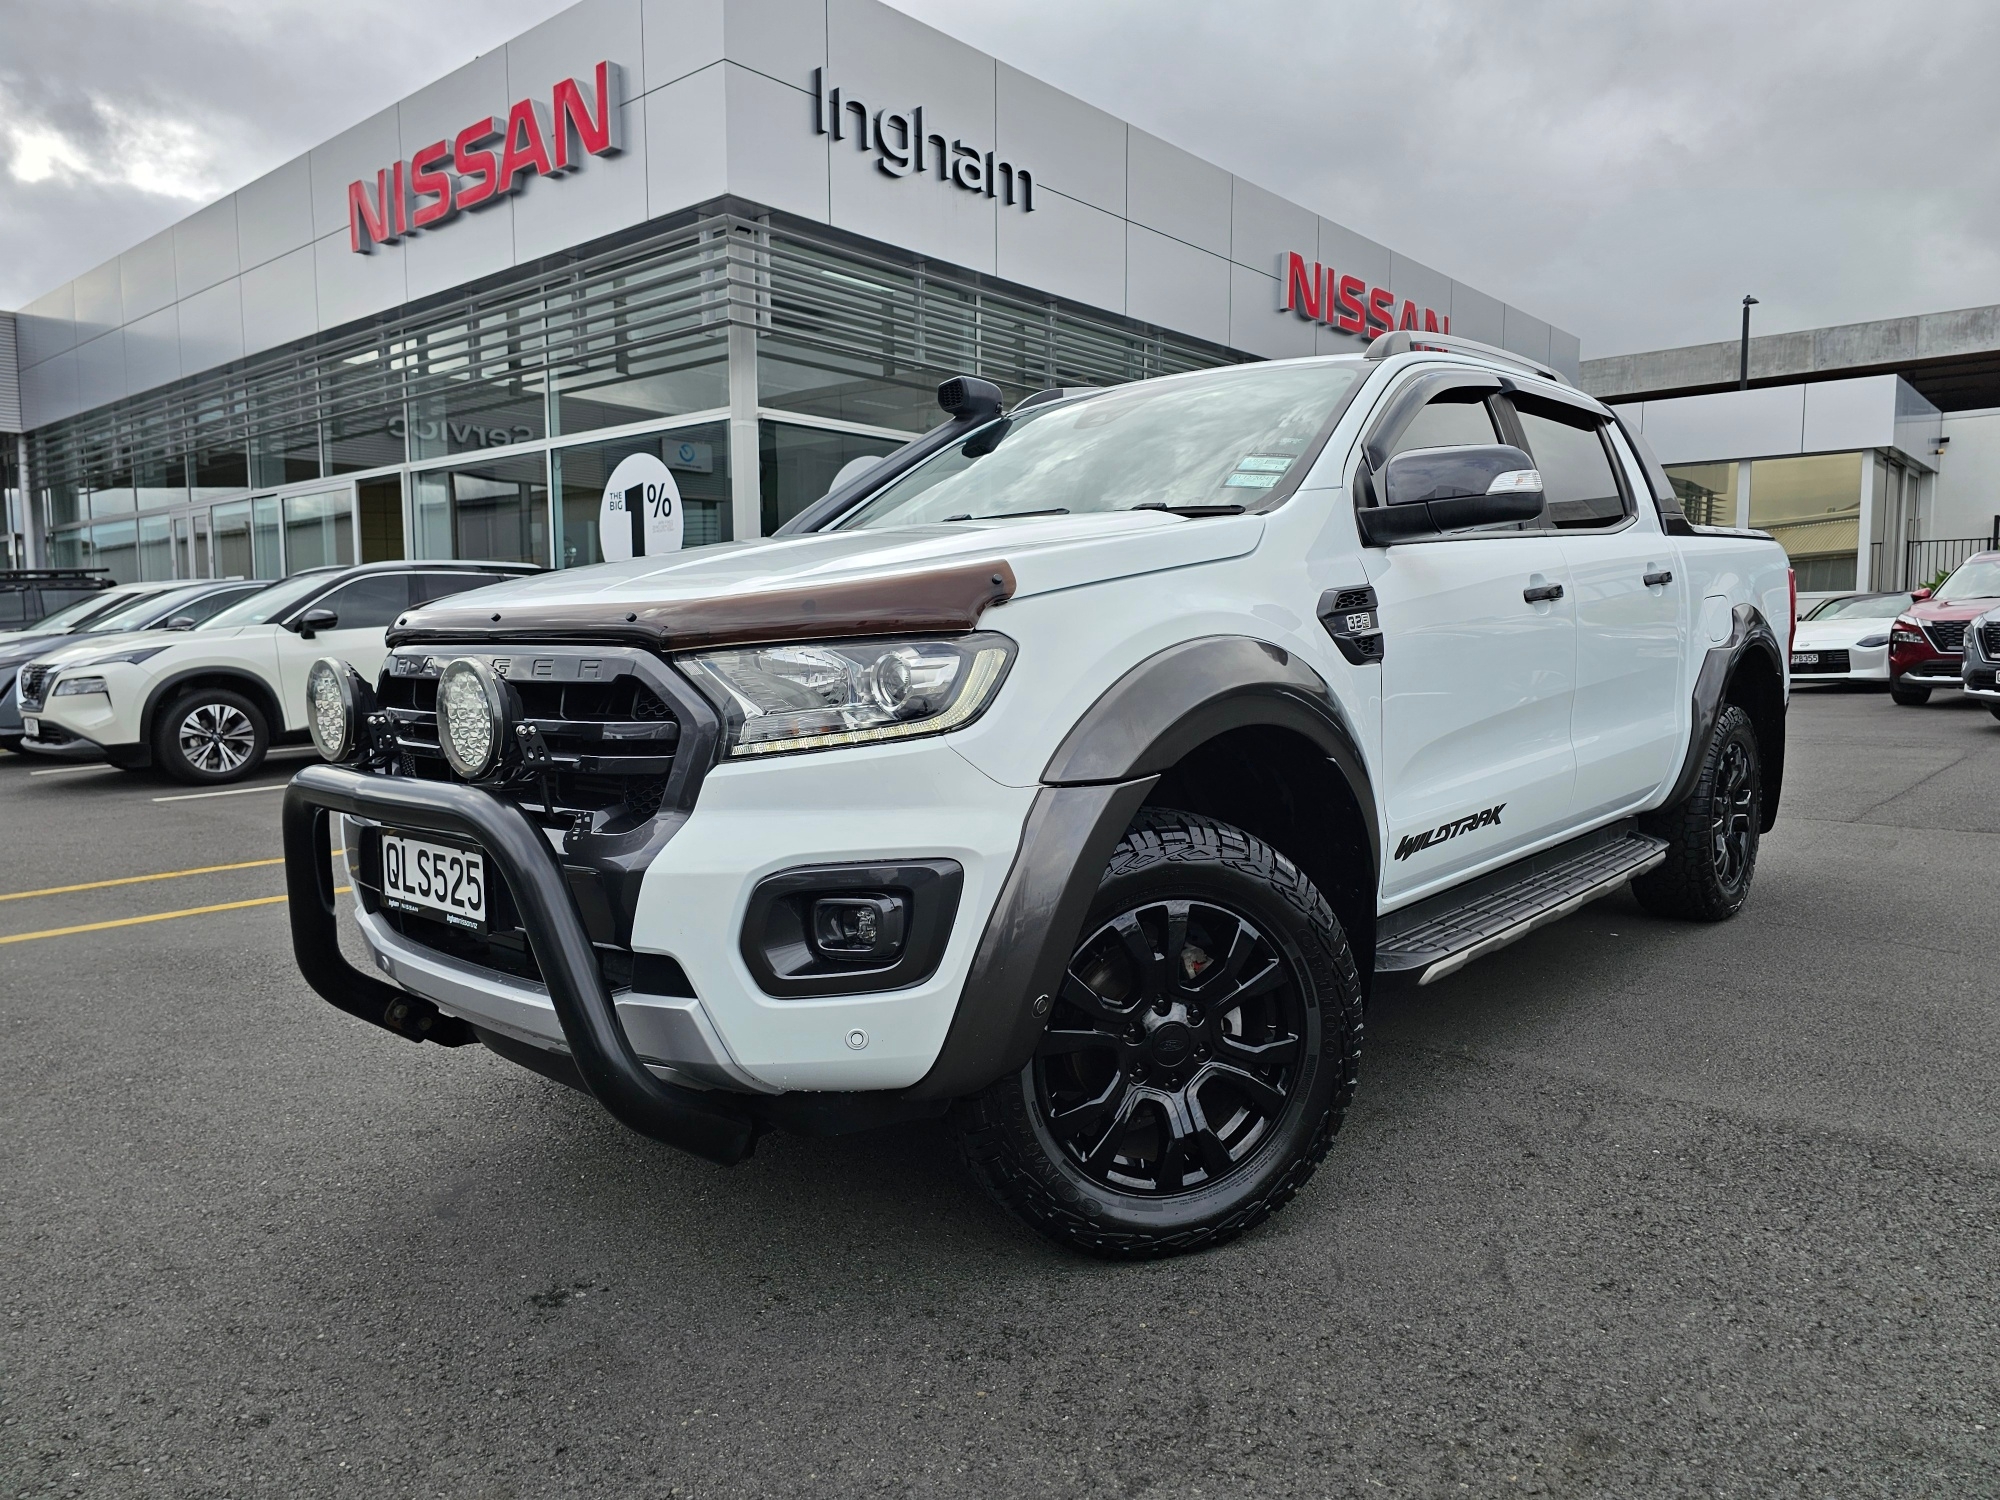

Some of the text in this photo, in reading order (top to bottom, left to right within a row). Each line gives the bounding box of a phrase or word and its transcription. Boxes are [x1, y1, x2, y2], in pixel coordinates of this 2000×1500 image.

[349, 60, 614, 254] NISSAN
[814, 66, 1037, 212] Ingham
[1285, 251, 1449, 341] NISSAN
[609, 492, 623, 500] THE
[609, 500, 623, 511] BIG
[394, 657, 604, 679] RAGER
[1394, 803, 1507, 861] WILDTRAK
[386, 842, 482, 911] QLS525
